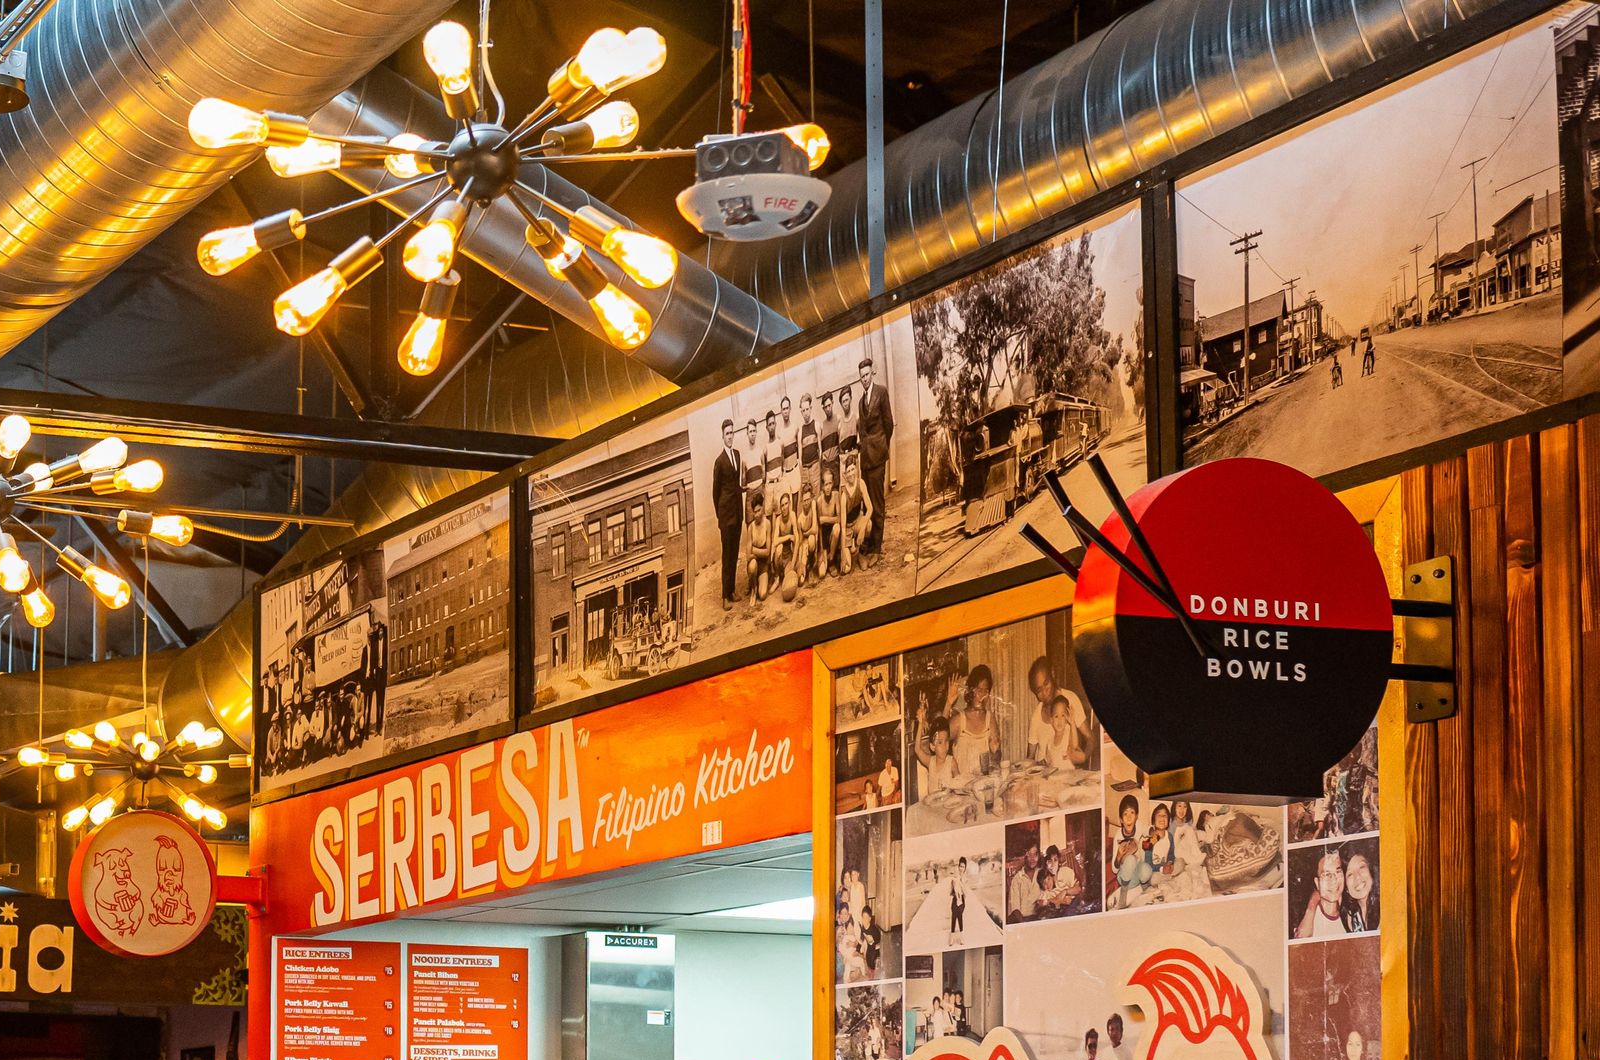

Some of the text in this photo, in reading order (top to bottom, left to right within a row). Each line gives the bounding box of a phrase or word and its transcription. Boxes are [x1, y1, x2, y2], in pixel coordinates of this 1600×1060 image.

[763, 197, 798, 211] FIRE
[1190, 594, 1321, 622] DONBURI
[1223, 627, 1290, 651] RICE
[1206, 658, 1307, 683] BOWLS
[592, 729, 795, 849] Filipino Kitchen
[312, 718, 585, 928] SERBESA
[614, 937, 654, 947] ACCUREX
[285, 950, 307, 958] RICE
[414, 956, 493, 966] NOODLE ENTREES
[284, 999, 302, 1007] Pork
[303, 1000, 322, 1008] Belly
[284, 1025, 302, 1033] Pork
[303, 1026, 322, 1034] Belly
[413, 1048, 496, 1057] DESSERTS, DRINKS
